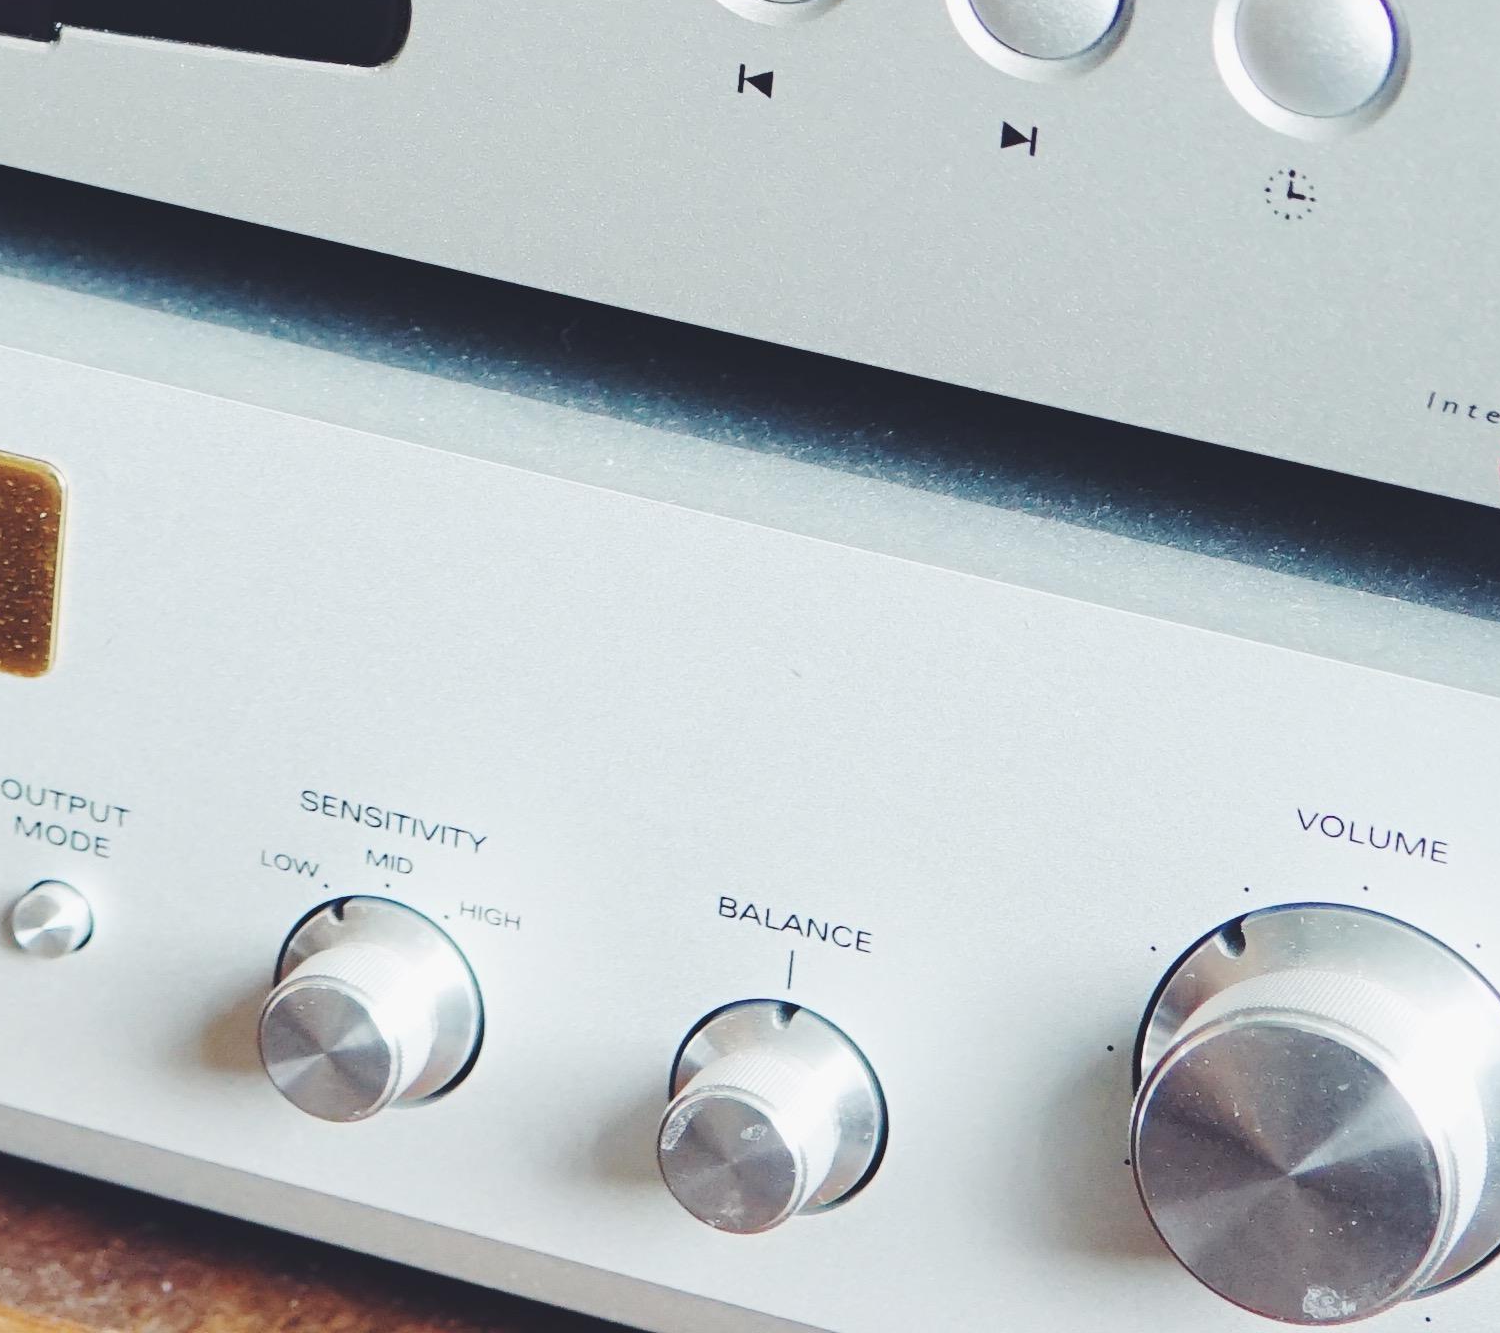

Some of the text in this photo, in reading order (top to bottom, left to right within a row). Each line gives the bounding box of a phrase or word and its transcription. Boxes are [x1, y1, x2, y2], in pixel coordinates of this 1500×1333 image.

[0, 778, 132, 828] OUTPUT
[300, 789, 489, 855] SENSITIVITY
[13, 815, 112, 859] MODE
[1296, 808, 1450, 865] VOLUME
[260, 849, 321, 879] LOW
[364, 848, 414, 876] MID
[459, 899, 523, 931] HIGH
[716, 894, 874, 955] BALANCE
